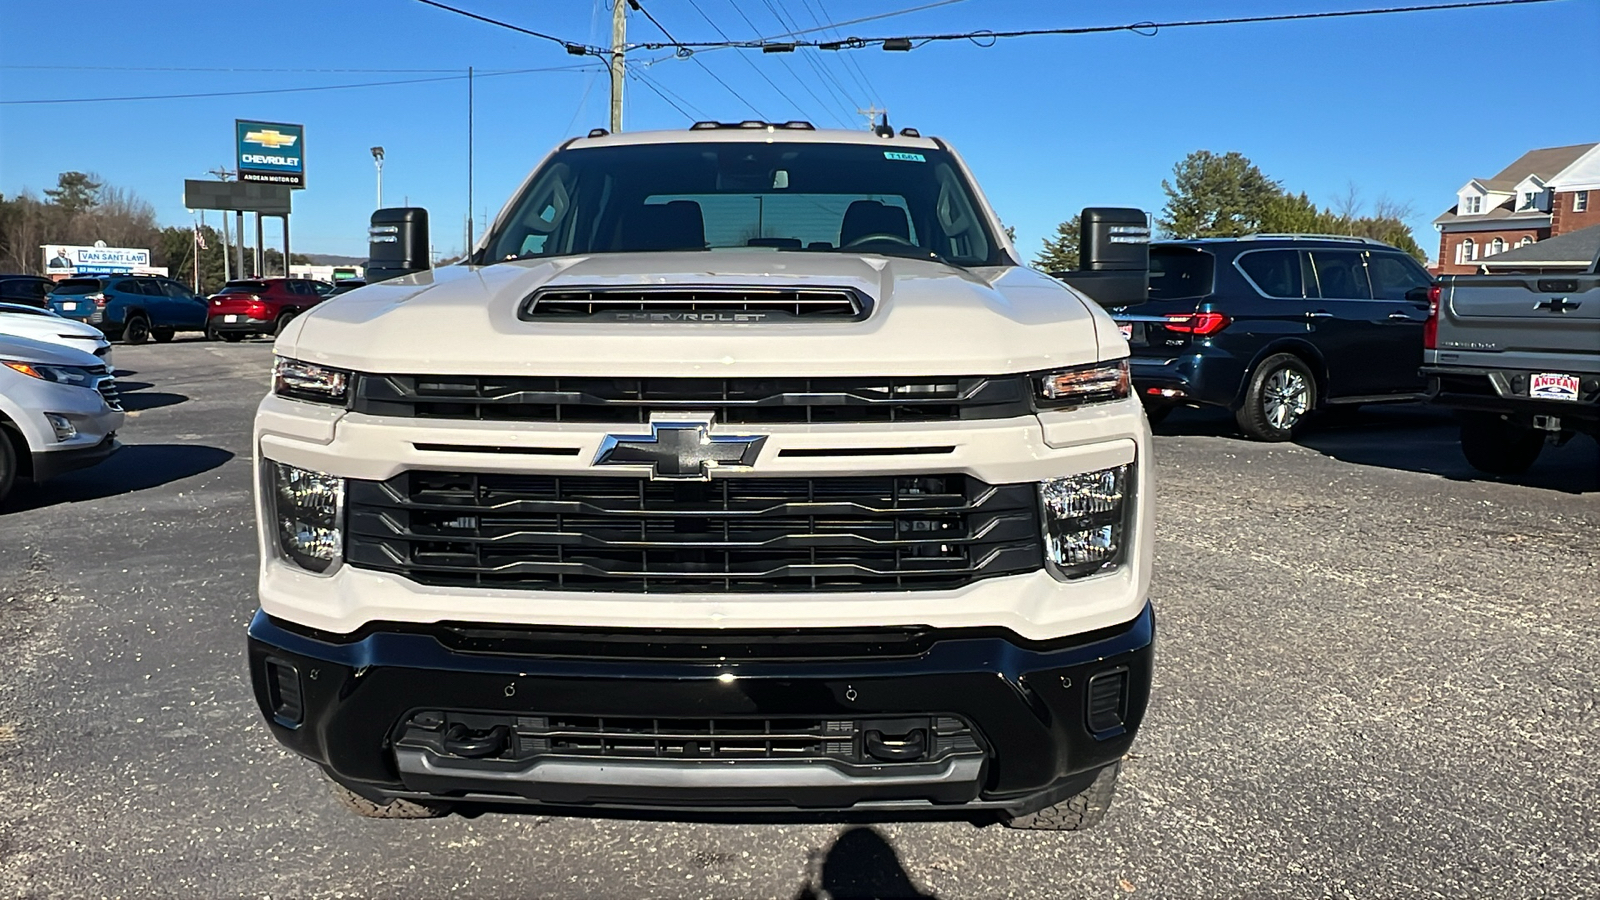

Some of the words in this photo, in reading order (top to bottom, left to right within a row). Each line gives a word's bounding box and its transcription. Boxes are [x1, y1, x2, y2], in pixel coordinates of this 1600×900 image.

[242, 154, 299, 166] CHEVROLET
[269, 175, 290, 183] MOTOR
[102, 253, 124, 261] SANT
[616, 313, 766, 322] CHEVROLET
[1533, 377, 1579, 392] ANDEAN
